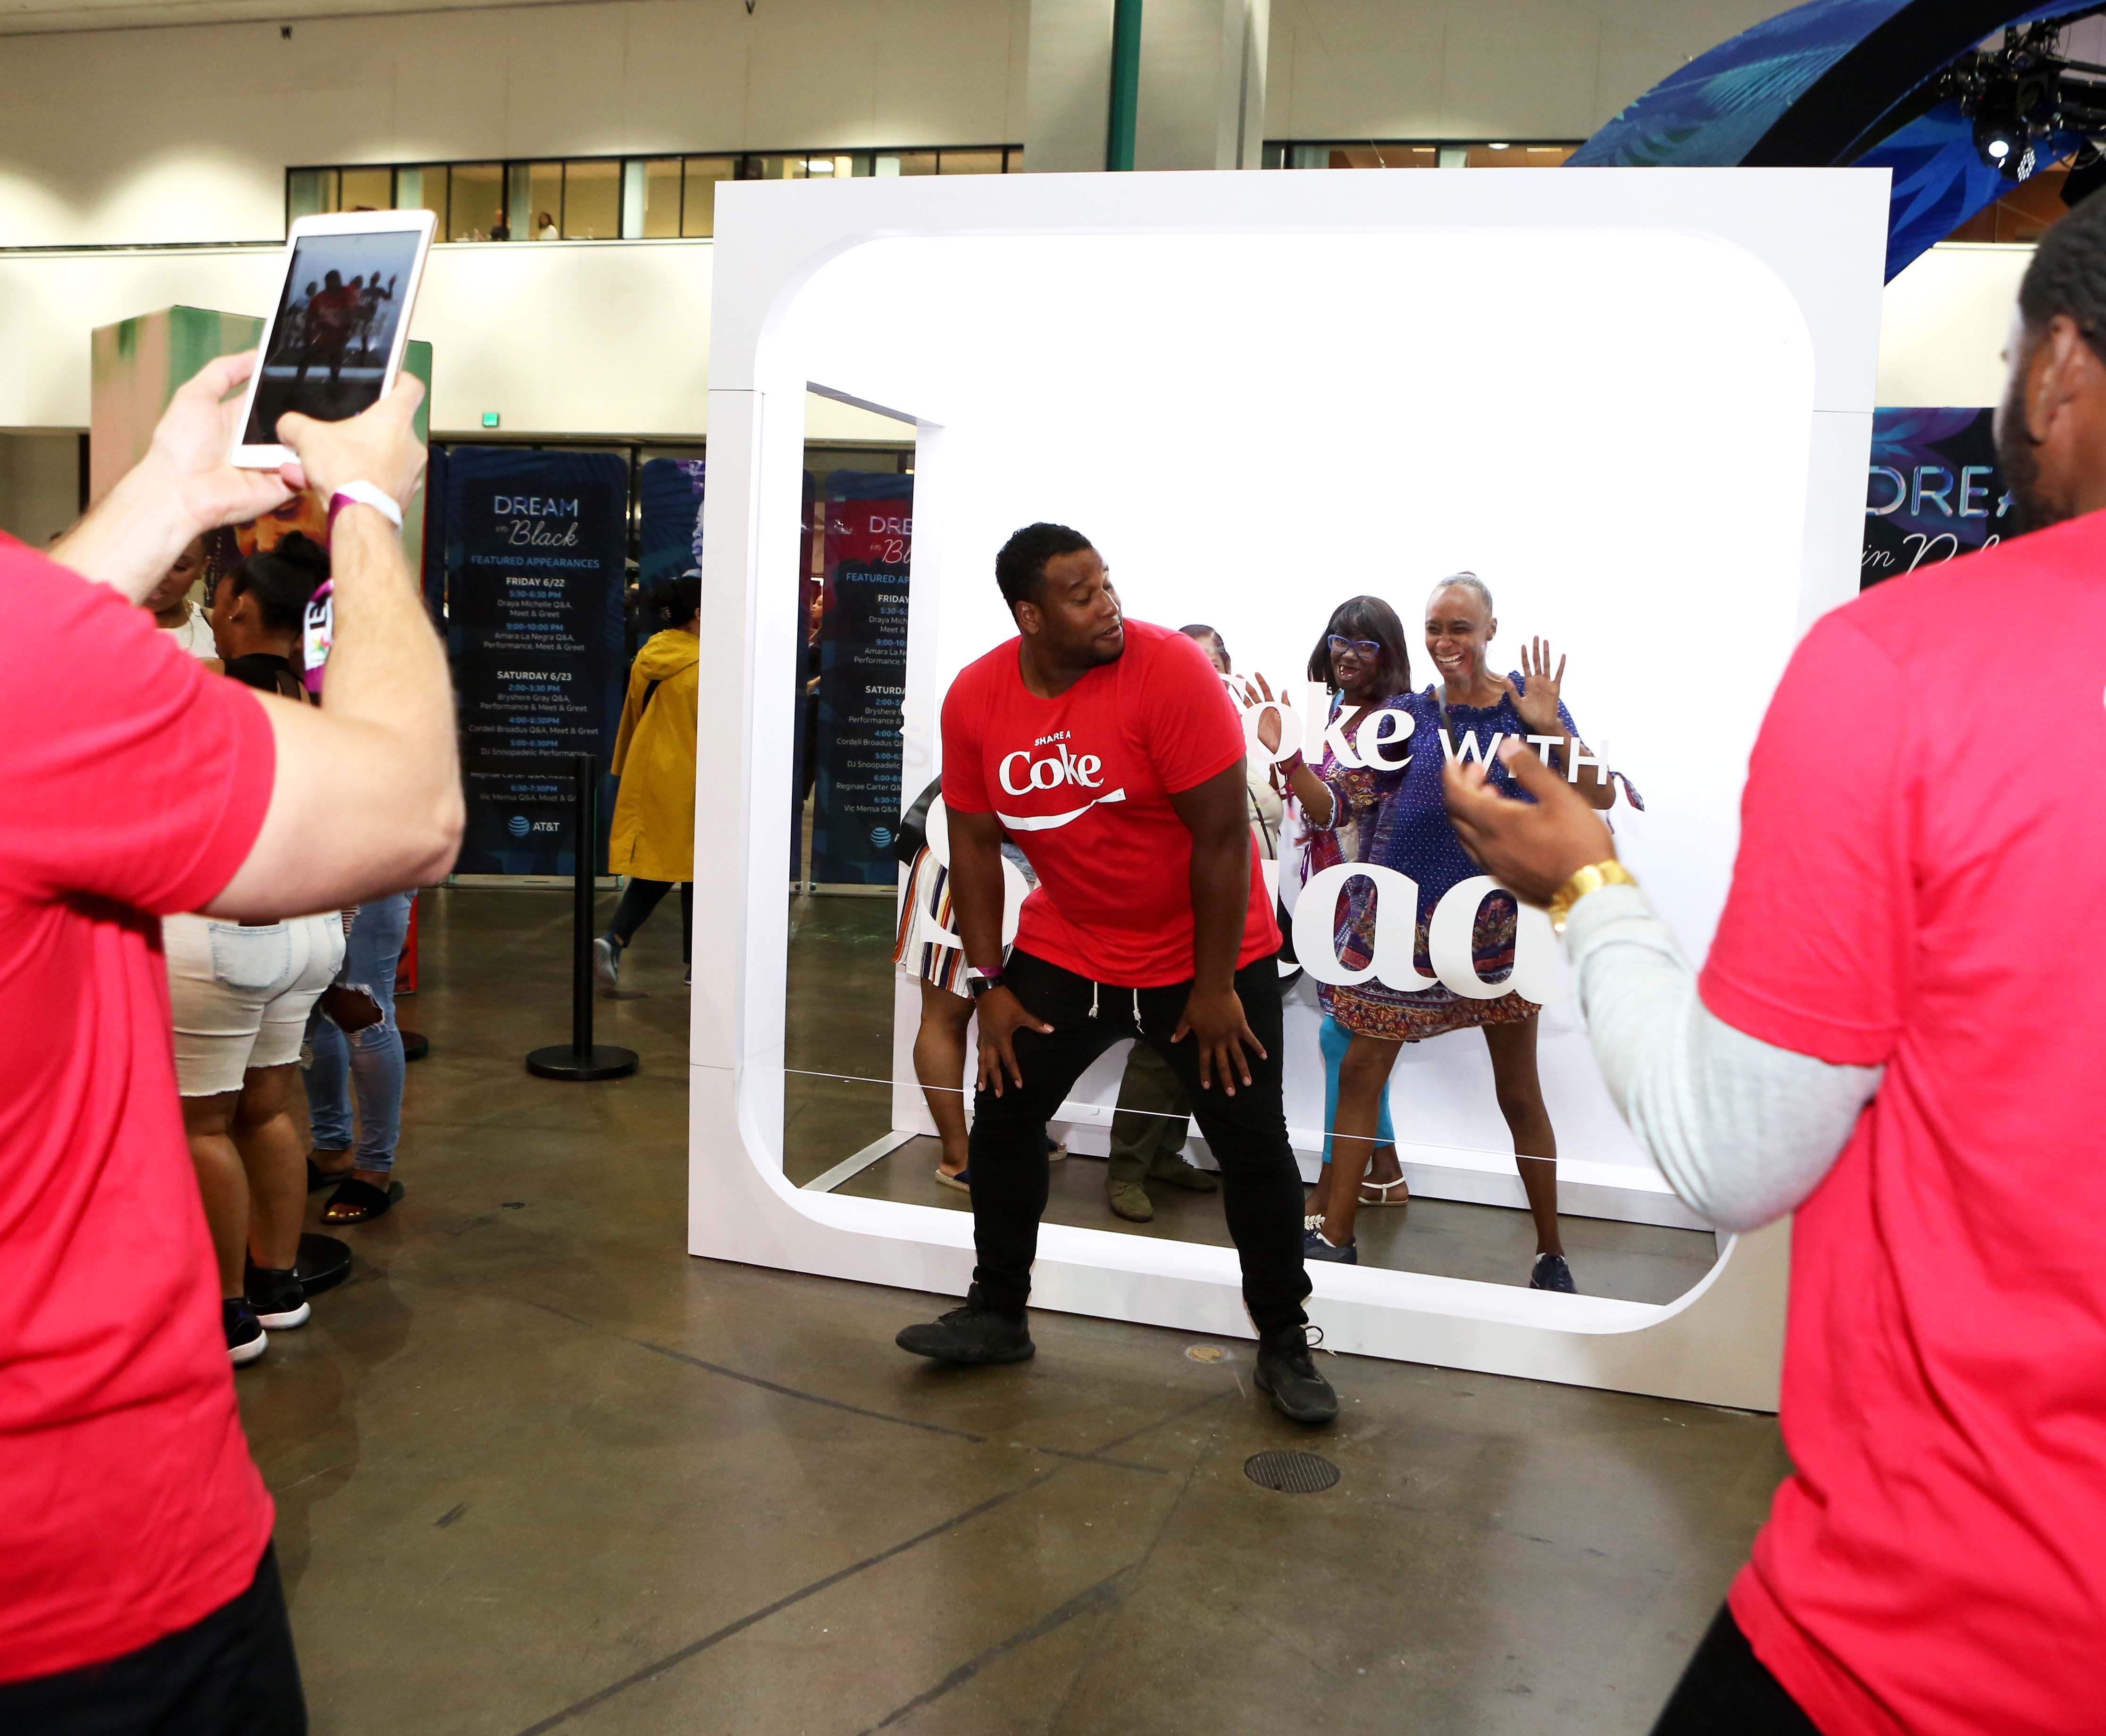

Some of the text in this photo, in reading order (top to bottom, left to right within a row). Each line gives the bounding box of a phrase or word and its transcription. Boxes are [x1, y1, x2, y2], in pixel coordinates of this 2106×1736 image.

[493, 495, 579, 517] DREAM
[509, 519, 579, 546] Black
[471, 555, 600, 568] FEATURED APPEARANCES
[506, 577, 565, 588] FRIDAY 6/22
[846, 572, 895, 584] FEATURED
[498, 599, 519, 608] Draya
[521, 600, 552, 608] Michelle
[878, 594, 909, 604] FRIDAY
[869, 615, 890, 625] Draya
[506, 623, 549, 631] 9:00-10:00
[880, 625, 898, 633] Meet
[532, 633, 554, 642] Negra
[864, 647, 888, 655] Amara
[497, 671, 572, 682] SATURDAY 6/23
[508, 684, 545, 693] 2:00-3:30
[498, 693, 530, 702] Bryshere
[532, 694, 549, 703] Gray
[480, 702, 529, 711] Performance
[865, 707, 897, 716] Bryshere
[848, 716, 902, 725] Performance &
[1219, 673, 1415, 771] oke
[468, 724, 495, 732] Cordell
[497, 726, 528, 734] Broadus
[836, 737, 862, 746] Cordell
[863, 738, 893, 746] Broadus
[1034, 730, 1072, 747] SHARE A
[480, 747, 490, 755] DJ
[492, 748, 537, 758] Snoopadelic
[847, 760, 901, 769] DJ Snoopadelic
[999, 743, 1105, 796] Coke
[836, 782, 865, 792] Reginae
[866, 783, 889, 791] Carter
[479, 793, 491, 801] Vic
[492, 793, 517, 801] Mensa
[844, 804, 856, 812] Vic
[856, 805, 880, 813] Mensa
[532, 822, 560, 832] AT&T
